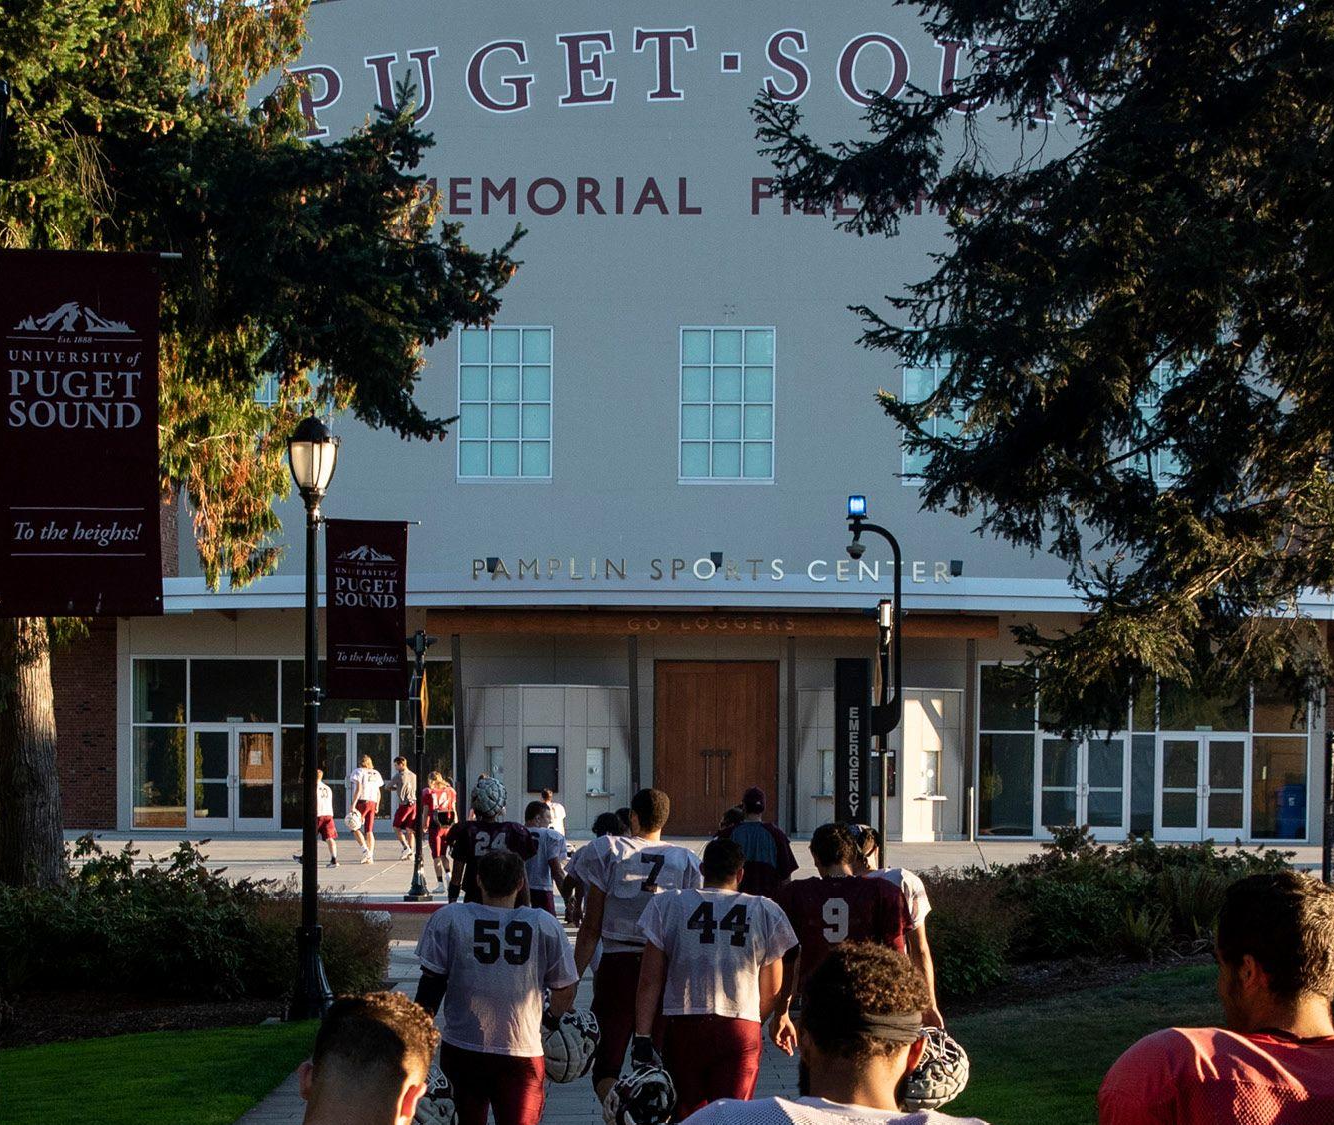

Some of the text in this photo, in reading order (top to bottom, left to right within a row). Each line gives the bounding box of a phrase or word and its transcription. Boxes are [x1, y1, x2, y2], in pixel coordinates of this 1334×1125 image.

[287, 26, 698, 140] PUGET
[9, 350, 142, 367] UNIVERSITY of
[8, 369, 142, 398] PUGET
[8, 400, 142, 429] SOUND
[13, 521, 142, 547] To the heights!
[472, 557, 627, 581] PAMPLIN
[650, 557, 784, 581] SPORTS
[335, 576, 398, 594] PUGET
[335, 592, 398, 609] SOUND
[627, 617, 661, 631] GO
[337, 650, 348, 662] To
[349, 651, 364, 662] the
[849, 706, 860, 817] EMERGENCY
[474, 830, 507, 857] 24
[639, 853, 665, 892] 7
[686, 901, 750, 947] 44
[821, 897, 850, 944] 9
[472, 919, 533, 965] 59
